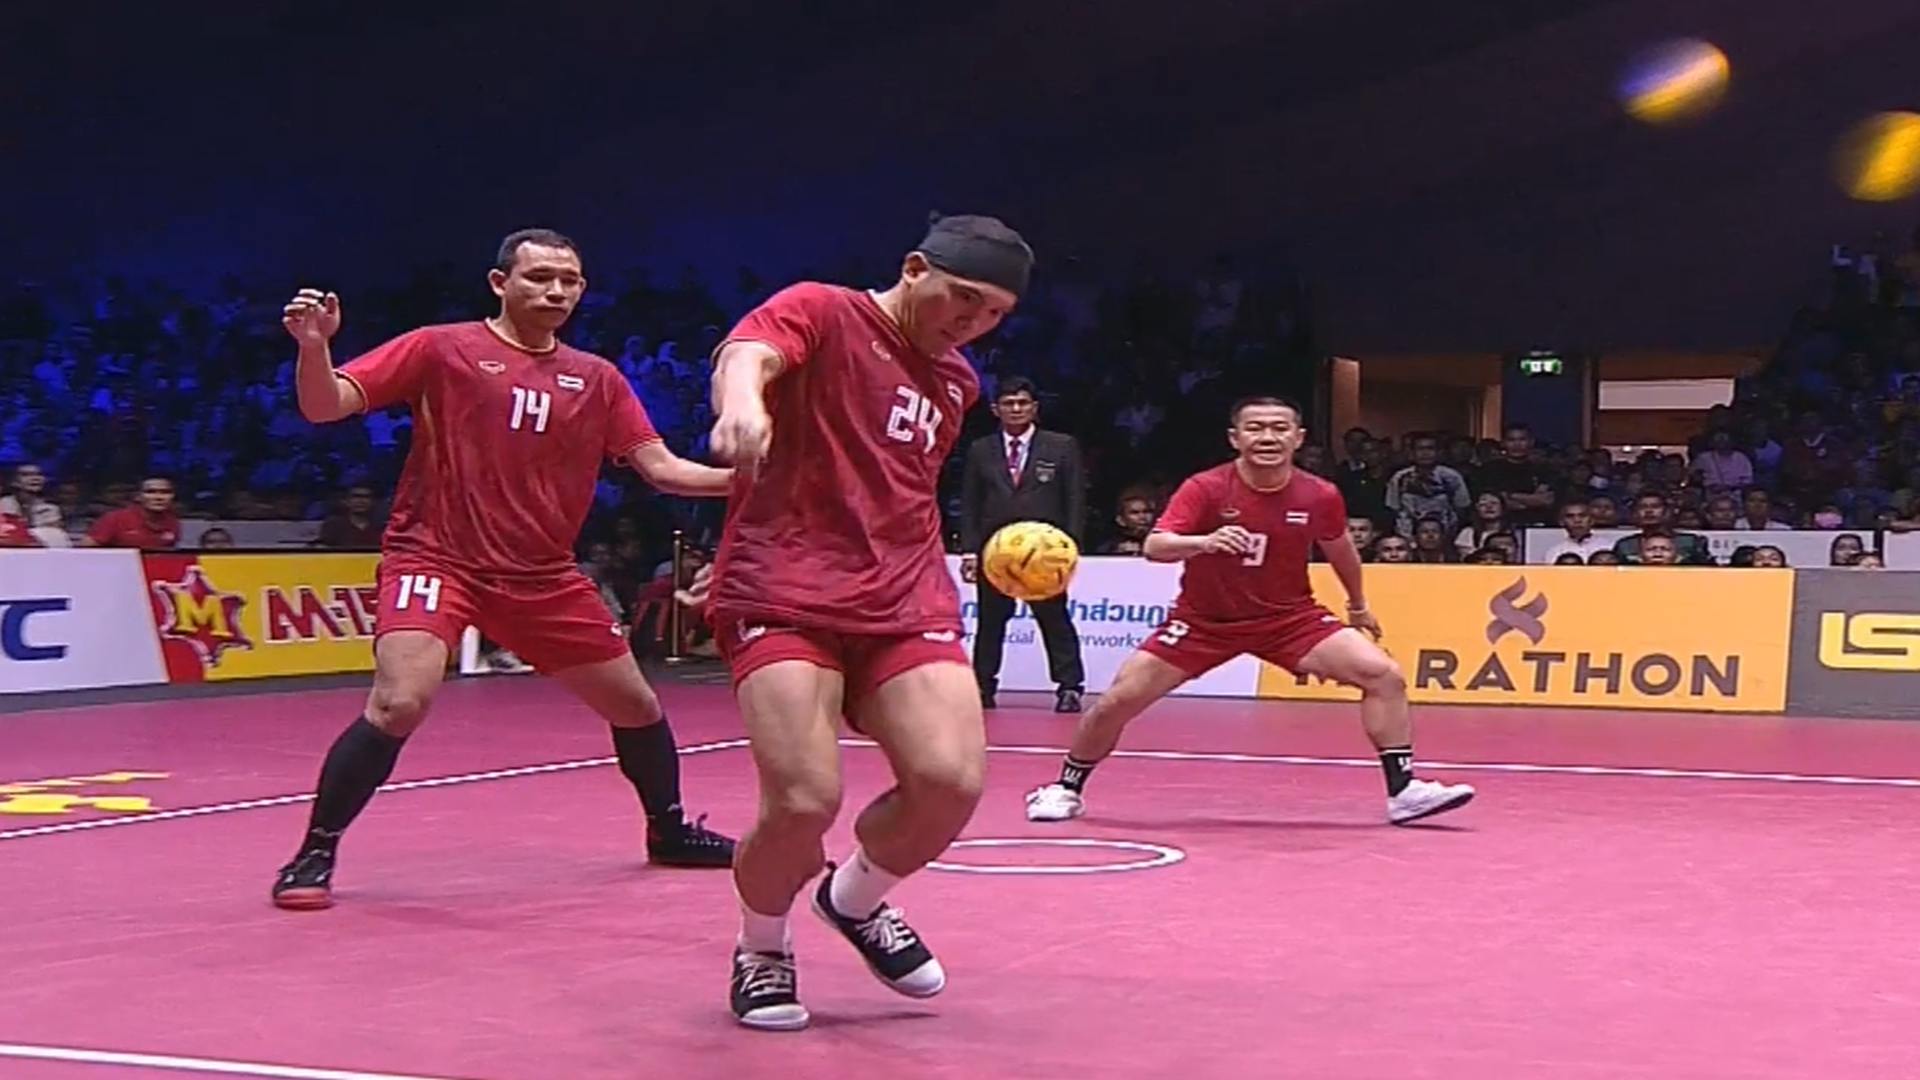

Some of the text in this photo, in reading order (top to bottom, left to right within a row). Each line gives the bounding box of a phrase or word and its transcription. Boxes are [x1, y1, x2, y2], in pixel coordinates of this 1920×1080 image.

[510, 386, 551, 433] 14
[886, 385, 943, 454] 24
[1240, 532, 1268, 567] 9
[173, 590, 234, 638] M
[396, 574, 442, 612] 14
[0, 597, 72, 662] C
[1296, 648, 1741, 698] RATHON
